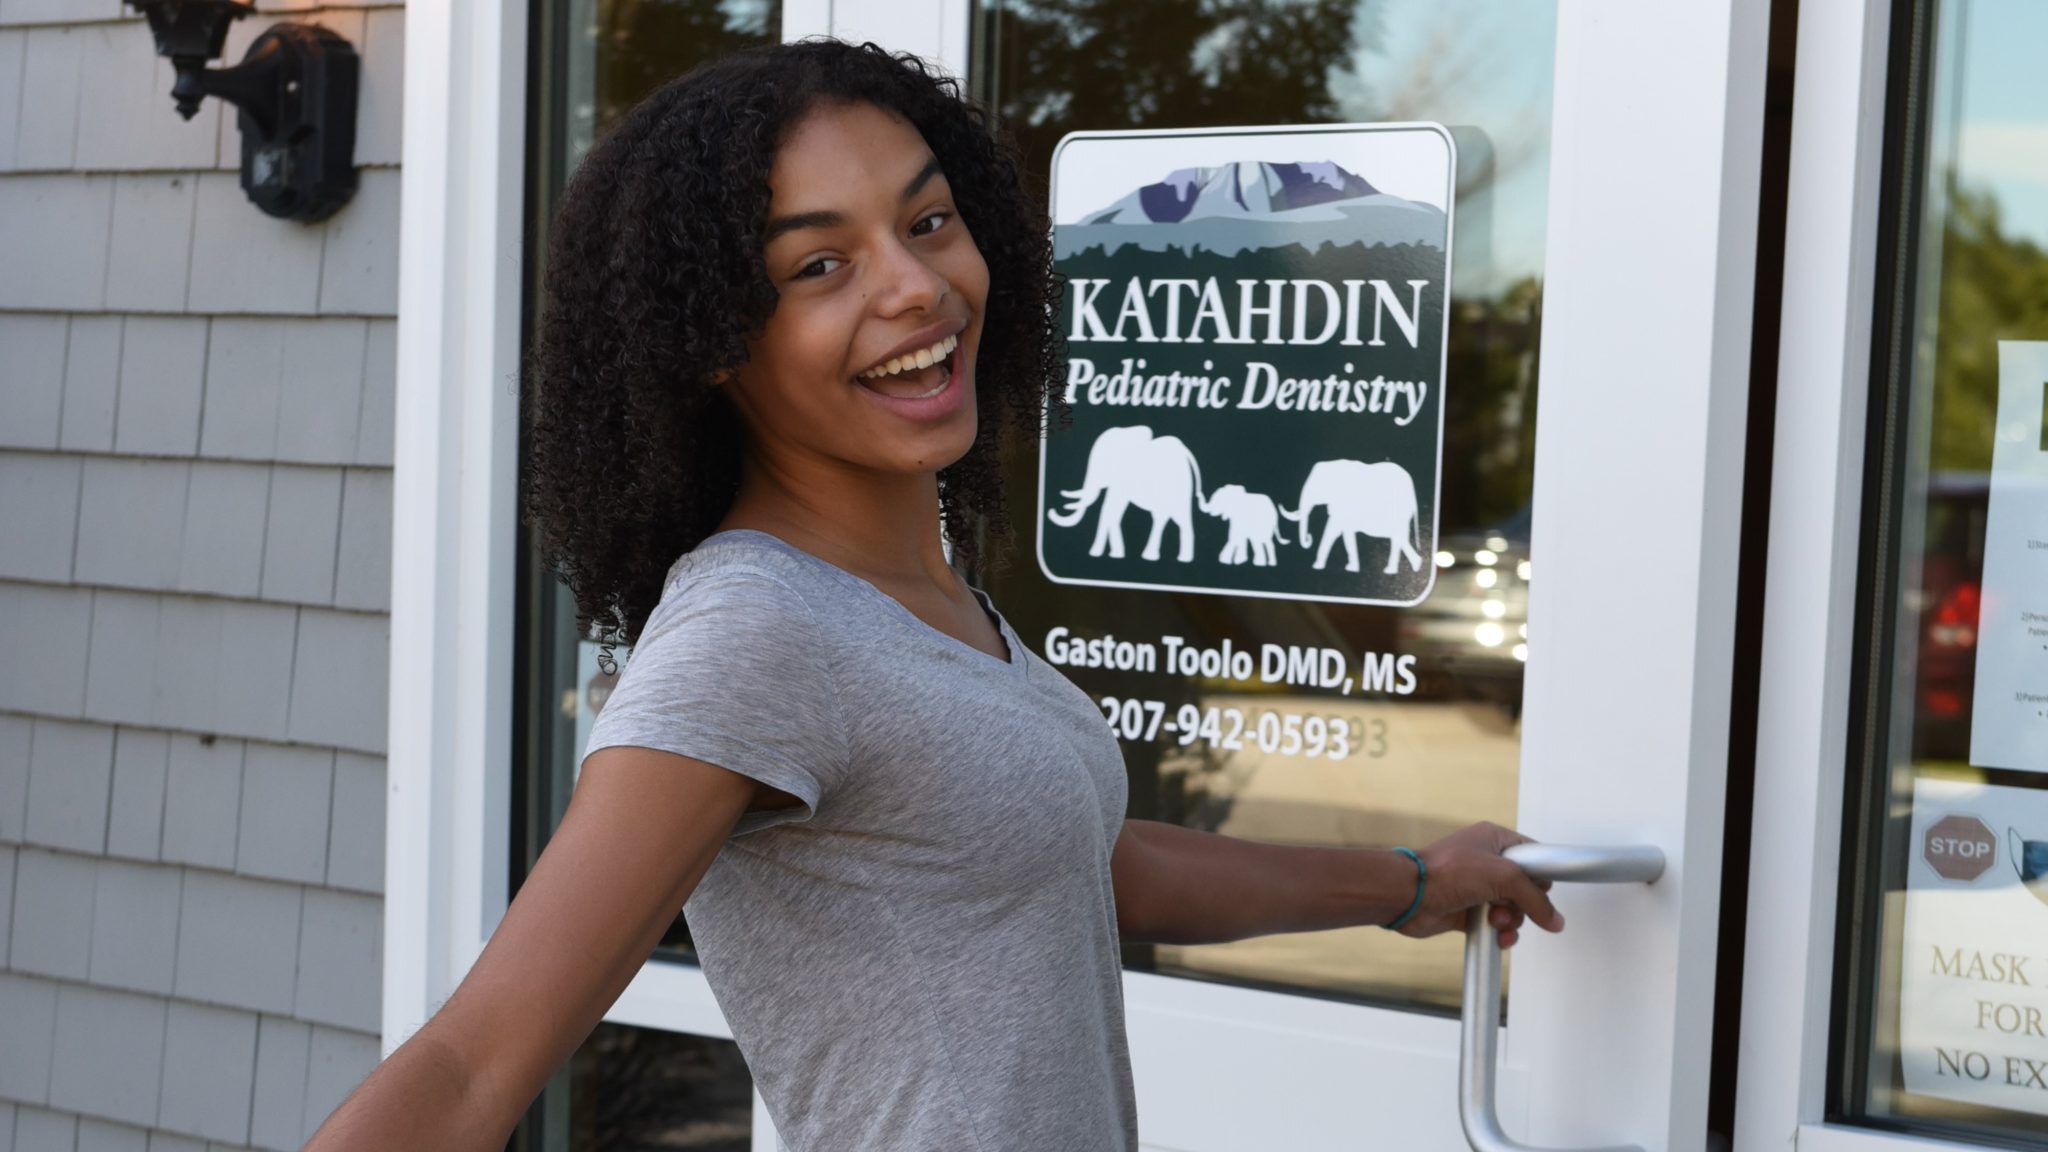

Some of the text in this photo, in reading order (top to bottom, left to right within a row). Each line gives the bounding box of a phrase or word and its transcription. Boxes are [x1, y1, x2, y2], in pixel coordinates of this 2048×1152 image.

[1067, 276, 1430, 349] KATAHDIN
[1065, 358, 1427, 426] Pediatric Dentistry
[1045, 627, 1417, 695] Gaston Toolo DMD, MS
[1101, 696, 1349, 761] 207-942-0593
[1930, 837, 1990, 859] STOP
[1930, 945, 2030, 987] MASK
[1976, 1000, 2047, 1038] FOR
[1935, 1047, 1991, 1082] NO
